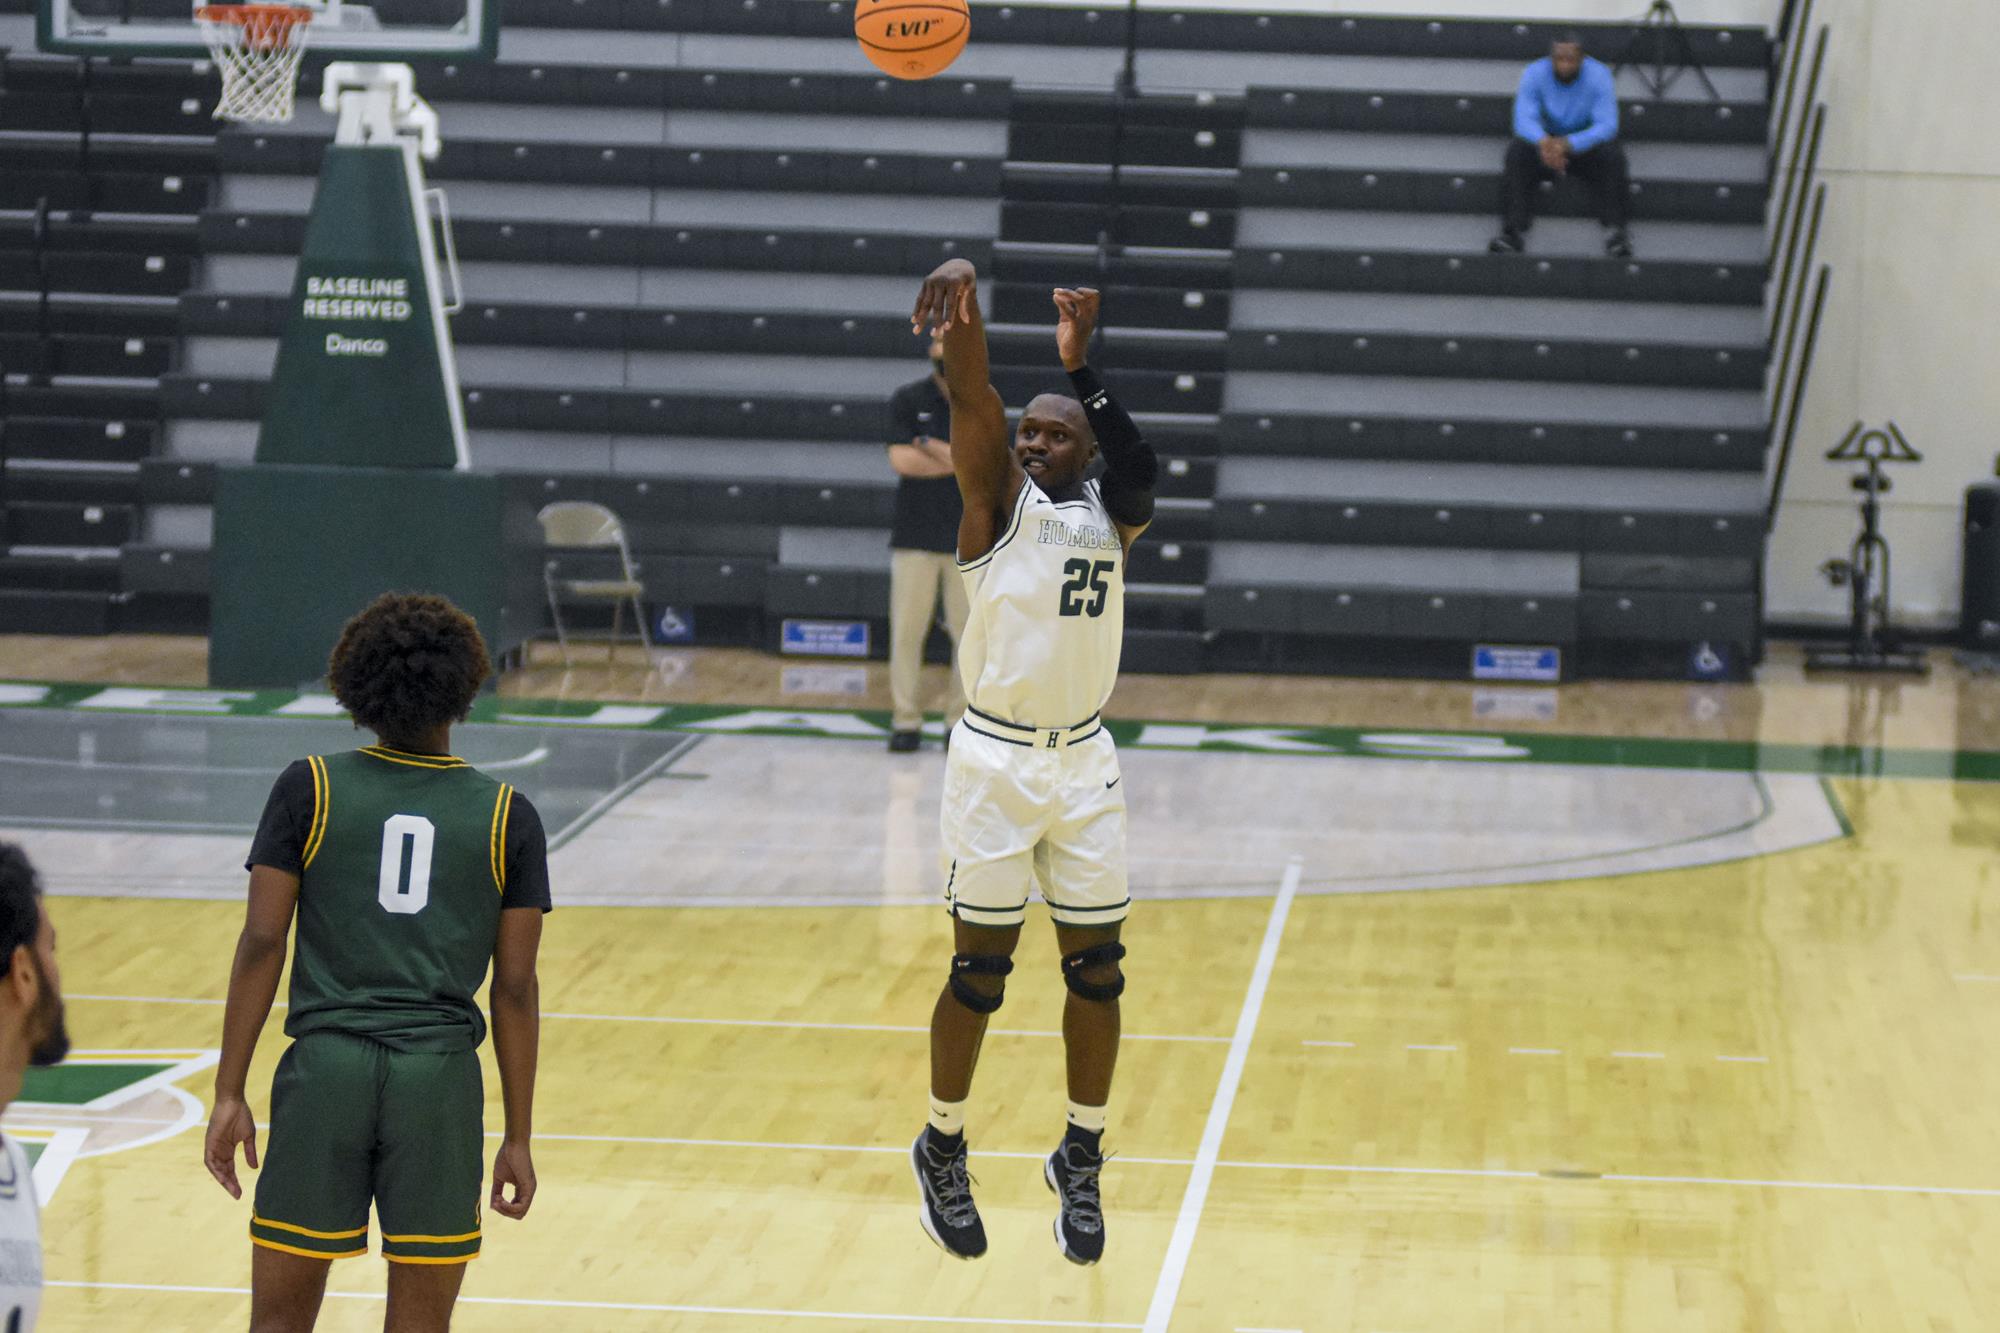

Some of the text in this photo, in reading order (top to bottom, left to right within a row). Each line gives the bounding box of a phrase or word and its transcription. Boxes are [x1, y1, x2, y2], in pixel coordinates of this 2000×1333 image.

[885, 20, 931, 37] EVO
[306, 277, 409, 297] BASELINE
[303, 299, 412, 320] RESERVED
[325, 333, 388, 356] Danco
[1058, 557, 1115, 617] 25
[1046, 731, 1060, 748] H
[378, 813, 435, 915] 0
